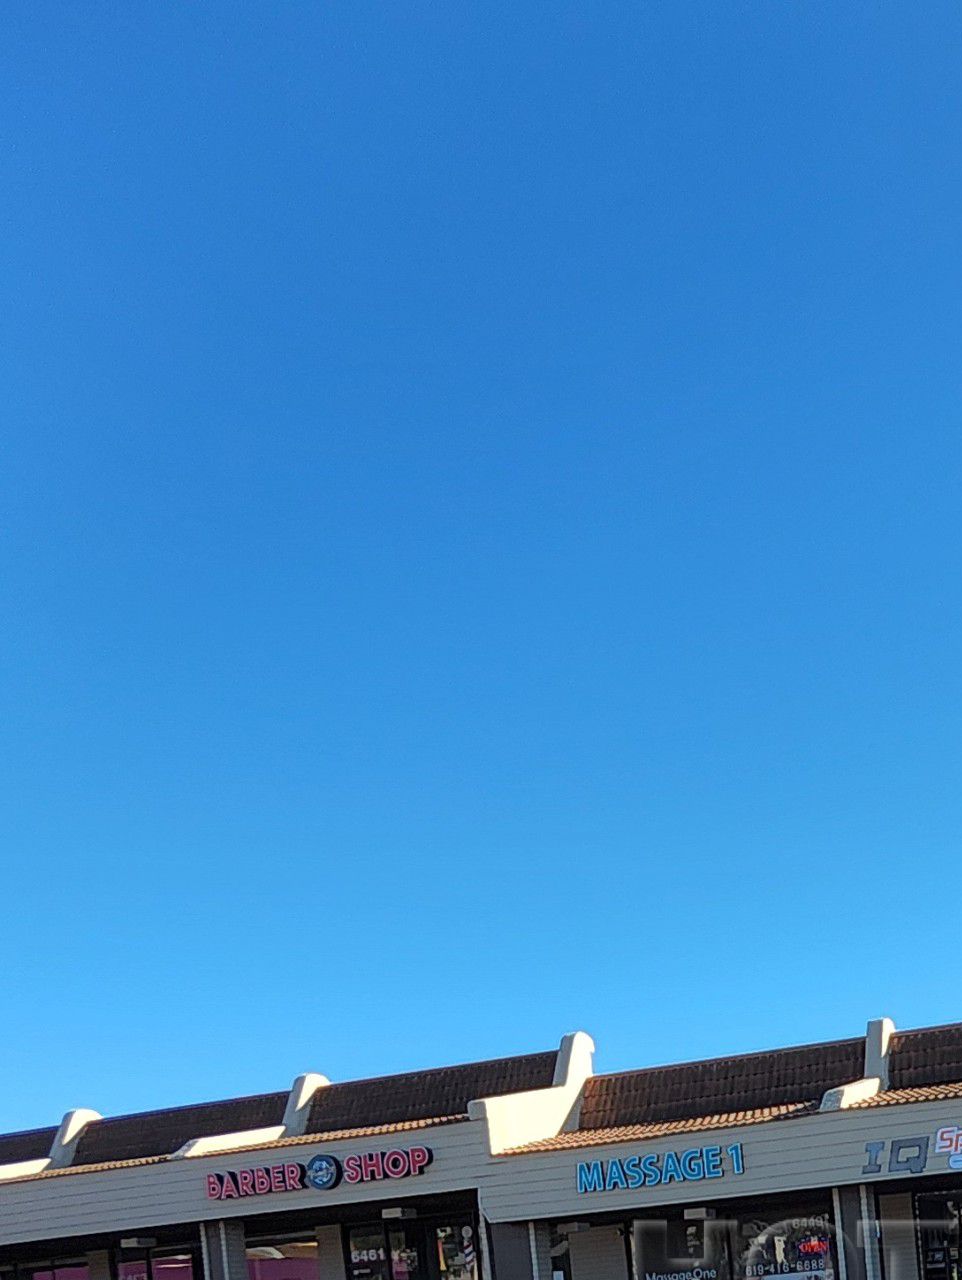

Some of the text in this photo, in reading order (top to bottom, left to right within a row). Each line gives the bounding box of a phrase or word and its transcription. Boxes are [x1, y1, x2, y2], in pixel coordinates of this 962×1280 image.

[206, 1145, 430, 1201] BARBER SHOP
[577, 1142, 745, 1193] MASSAGE 1
[861, 1135, 930, 1174] IQ
